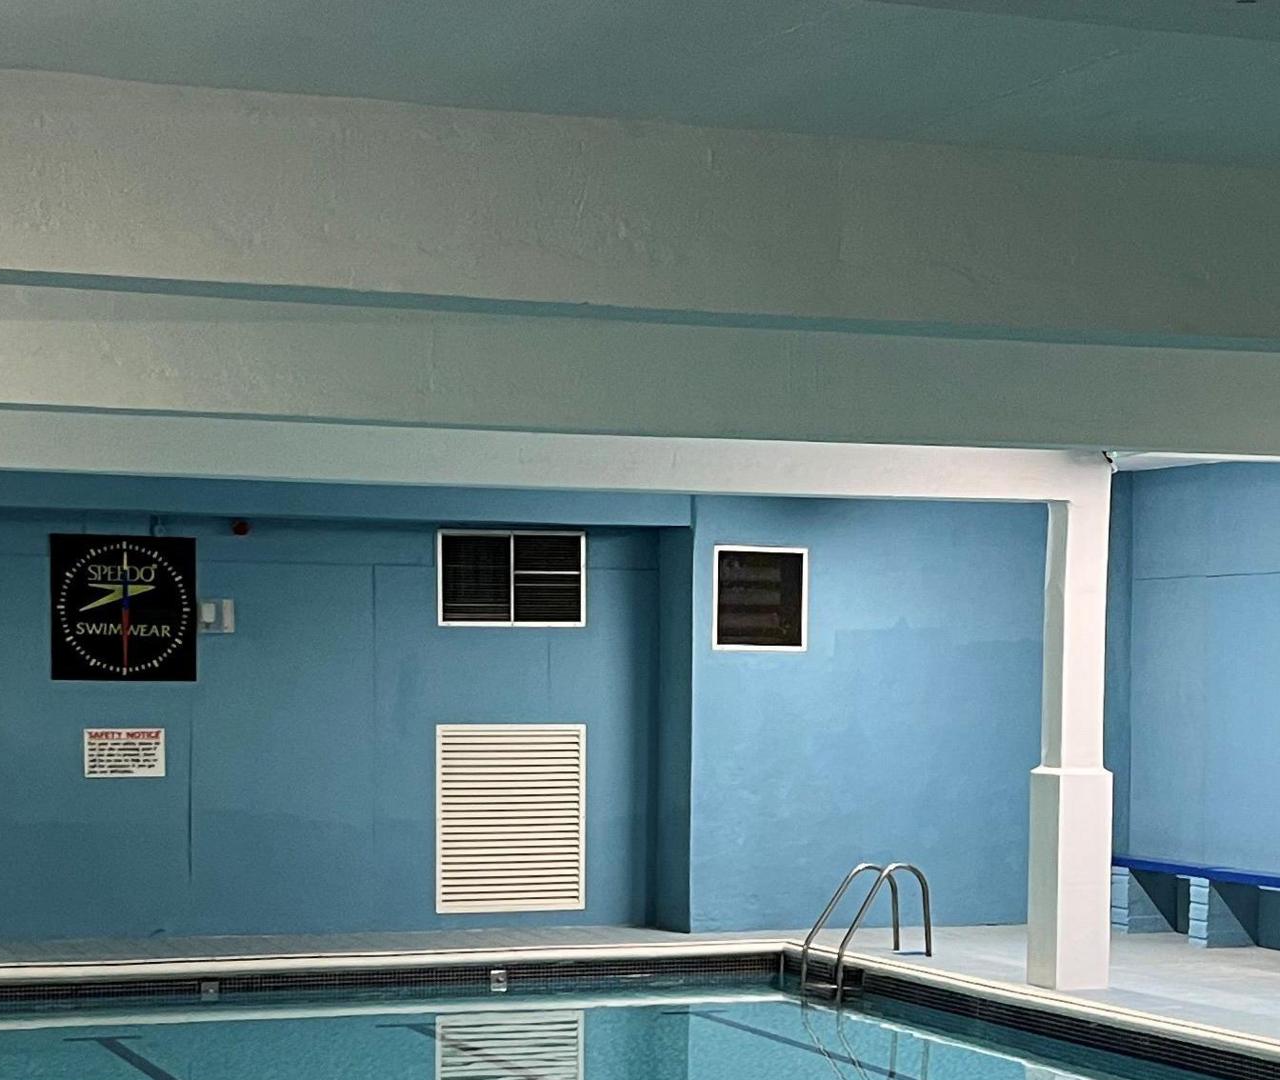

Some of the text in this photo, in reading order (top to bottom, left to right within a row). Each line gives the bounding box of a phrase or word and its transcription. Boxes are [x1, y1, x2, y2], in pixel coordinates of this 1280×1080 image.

[87, 564, 156, 583] SPEEDO
[75, 622, 172, 638] SWIMWEAR
[87, 730, 161, 739] SAFETY NOTICE
